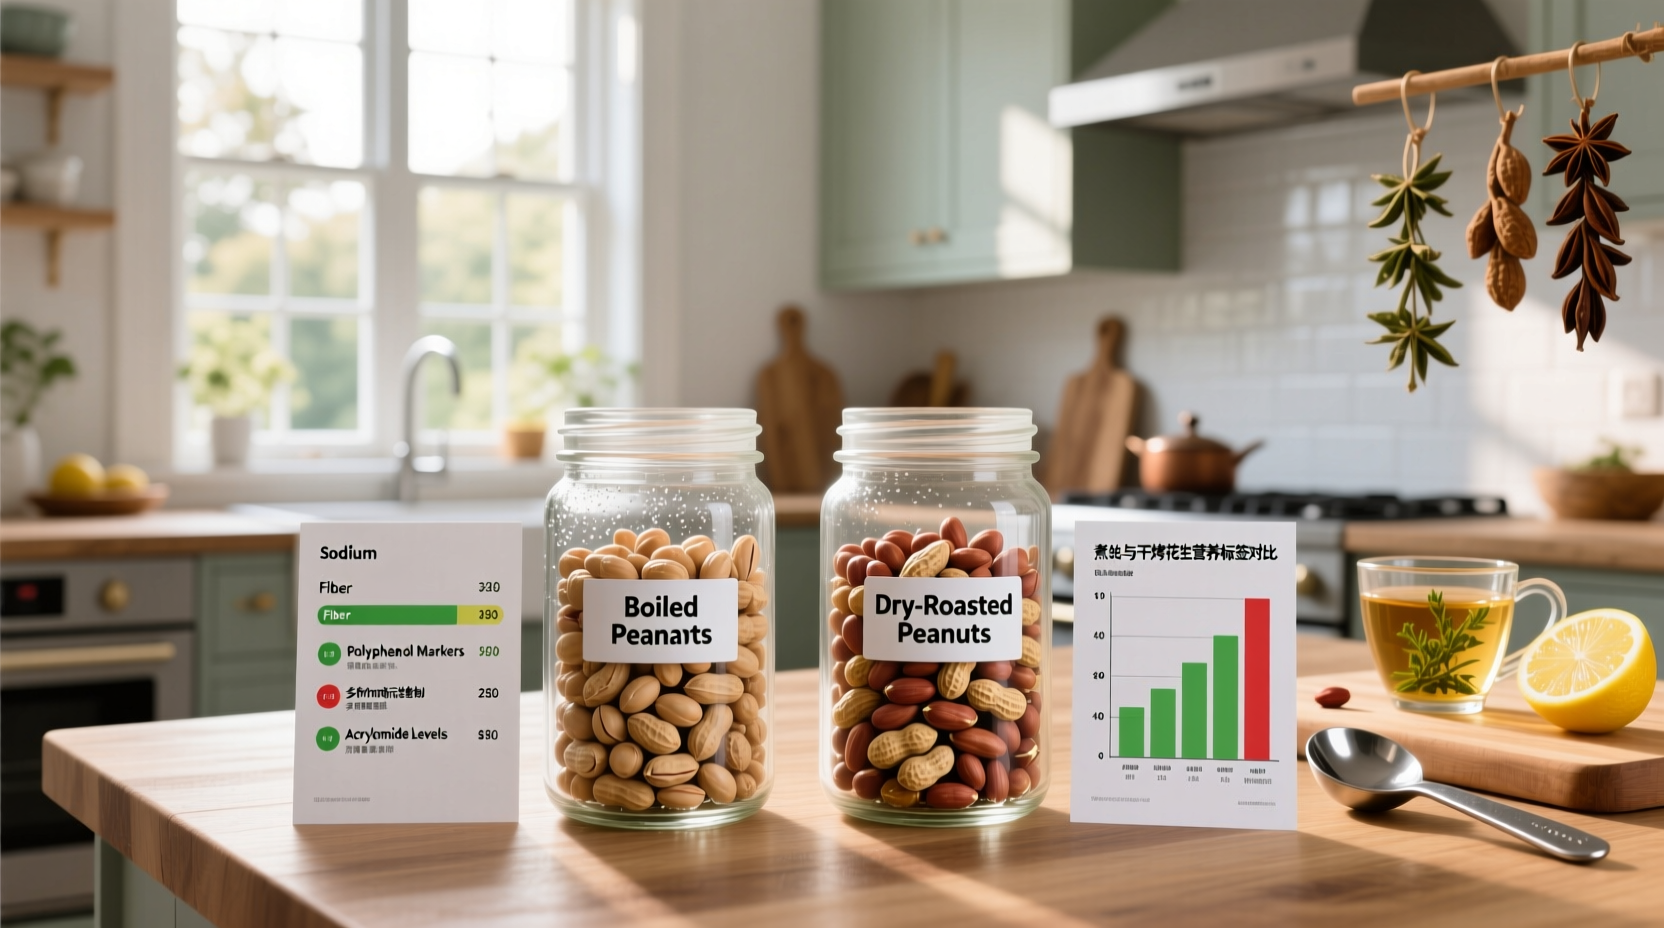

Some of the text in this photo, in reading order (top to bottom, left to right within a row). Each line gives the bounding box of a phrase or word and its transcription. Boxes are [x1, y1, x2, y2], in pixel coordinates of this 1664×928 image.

[320, 544, 377, 560] Sodium
[624, 595, 698, 618] Boiled
[875, 593, 1013, 620] Dry-Roasted
[897, 621, 992, 643] Peanuts
[347, 644, 414, 660] Polyphenol
[416, 645, 465, 657] Markers
[411, 727, 448, 740] Levels
